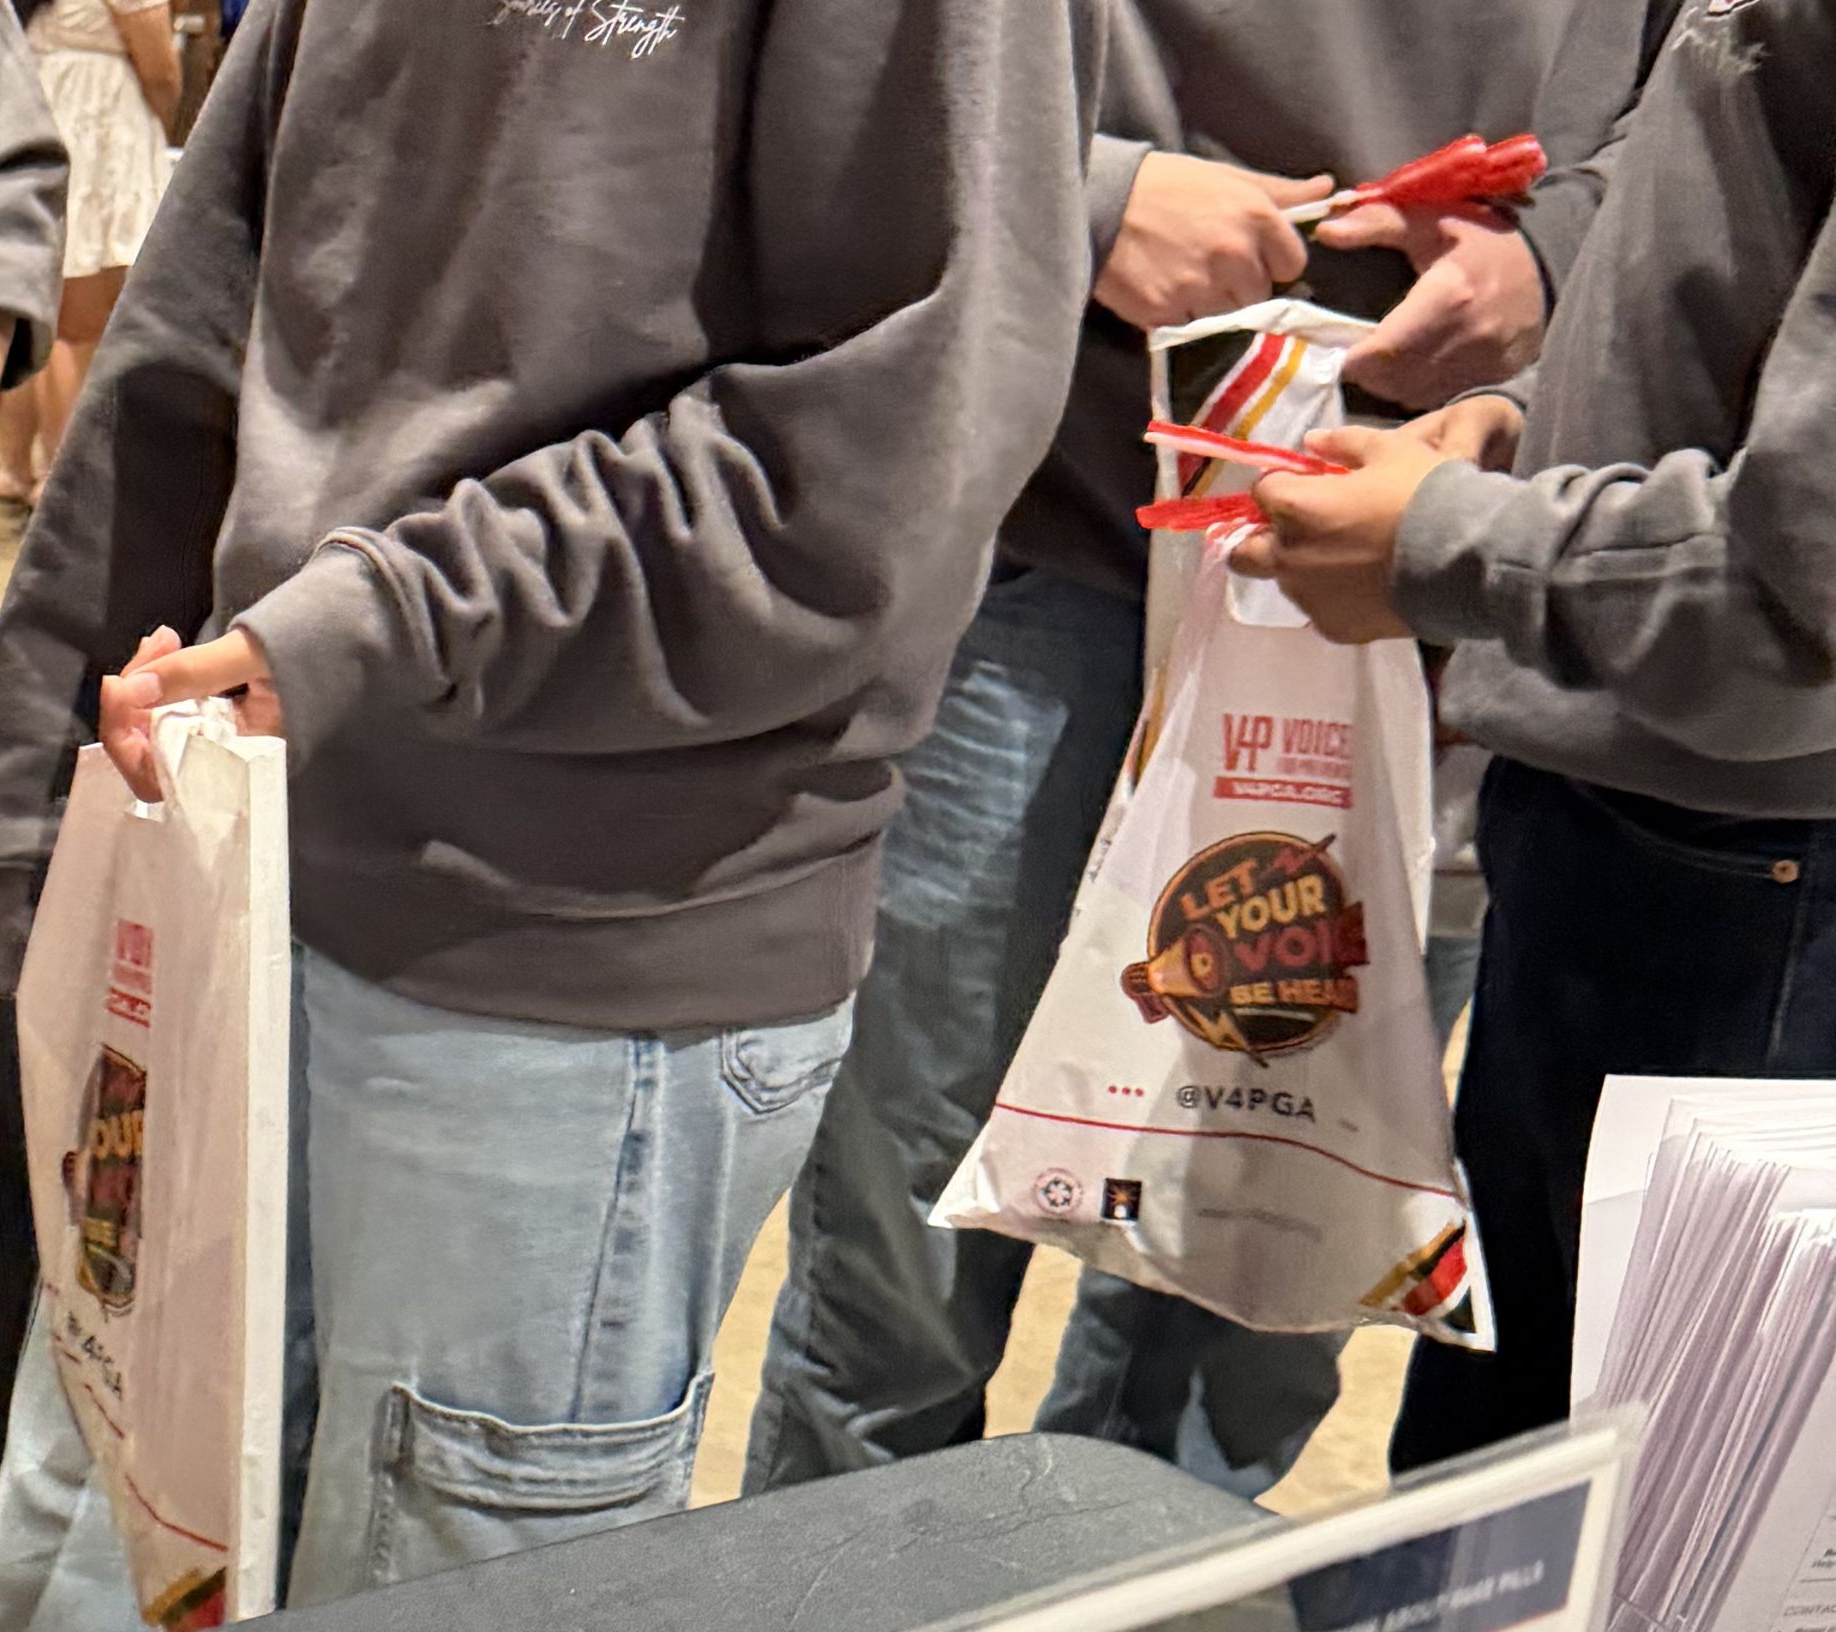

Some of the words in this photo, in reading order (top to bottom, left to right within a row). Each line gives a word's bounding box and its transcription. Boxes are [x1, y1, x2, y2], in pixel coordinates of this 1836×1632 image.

[1180, 857, 1260, 922] LET
[1215, 873, 1325, 941] YOUR
[1230, 980, 1275, 1006] BE
[1175, 1083, 1317, 1124] @V4PGA
